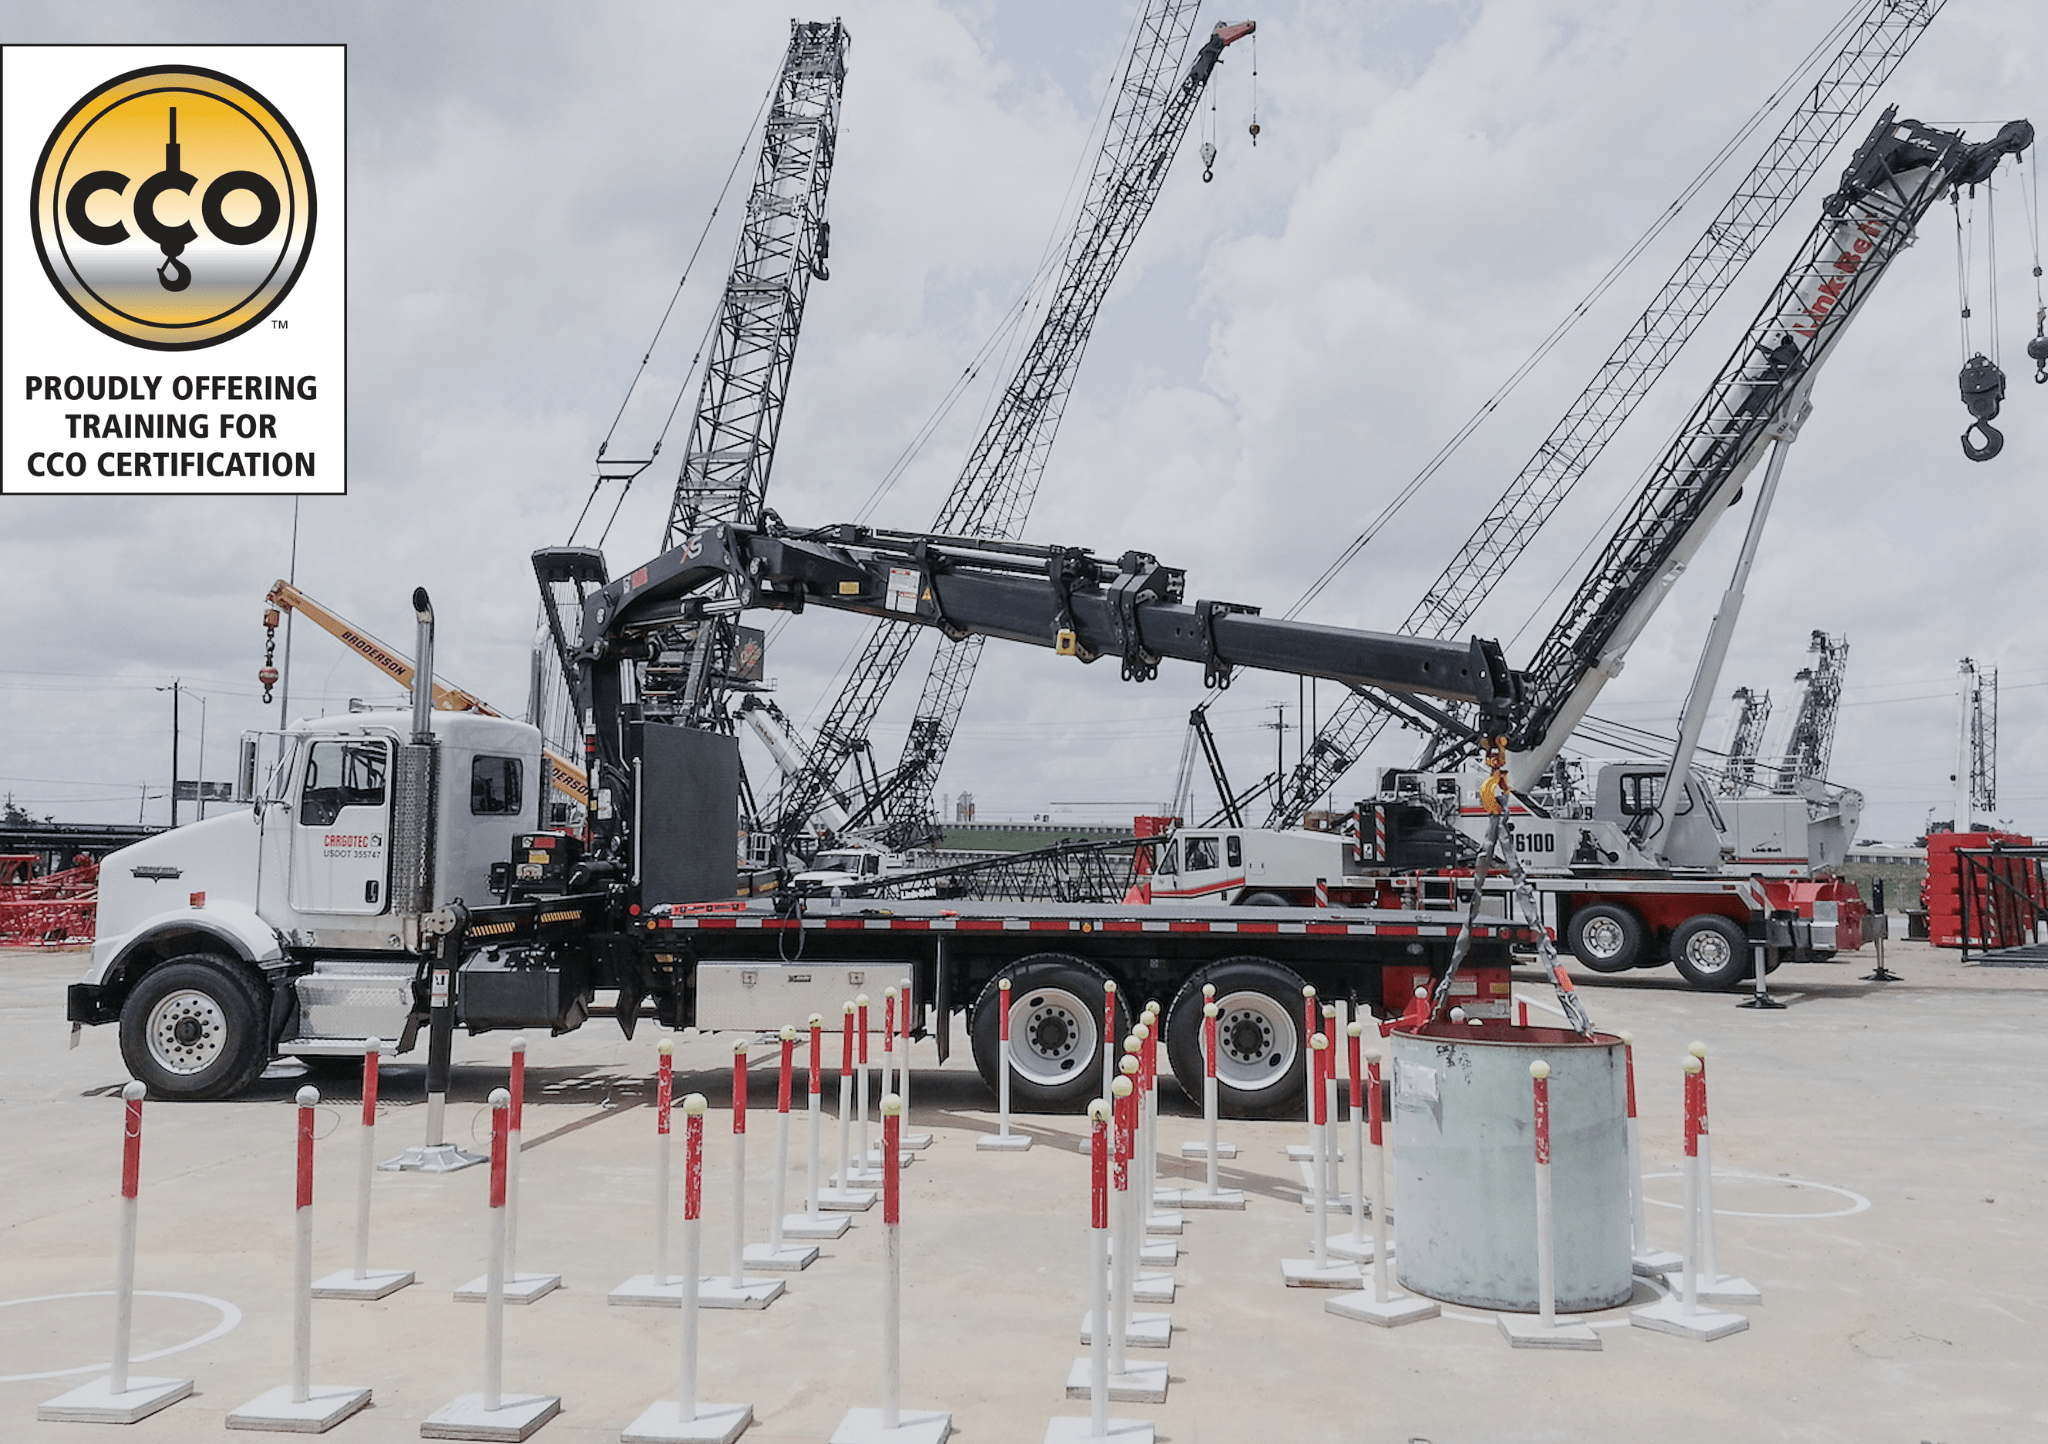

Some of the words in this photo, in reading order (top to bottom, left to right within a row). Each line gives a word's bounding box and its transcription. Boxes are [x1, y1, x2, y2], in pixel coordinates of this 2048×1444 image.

[341, 630, 407, 676] BRODERSON
[324, 834, 369, 848] CARGOTEC
[323, 850, 352, 859] USDOT
[353, 850, 381, 859] 355747
